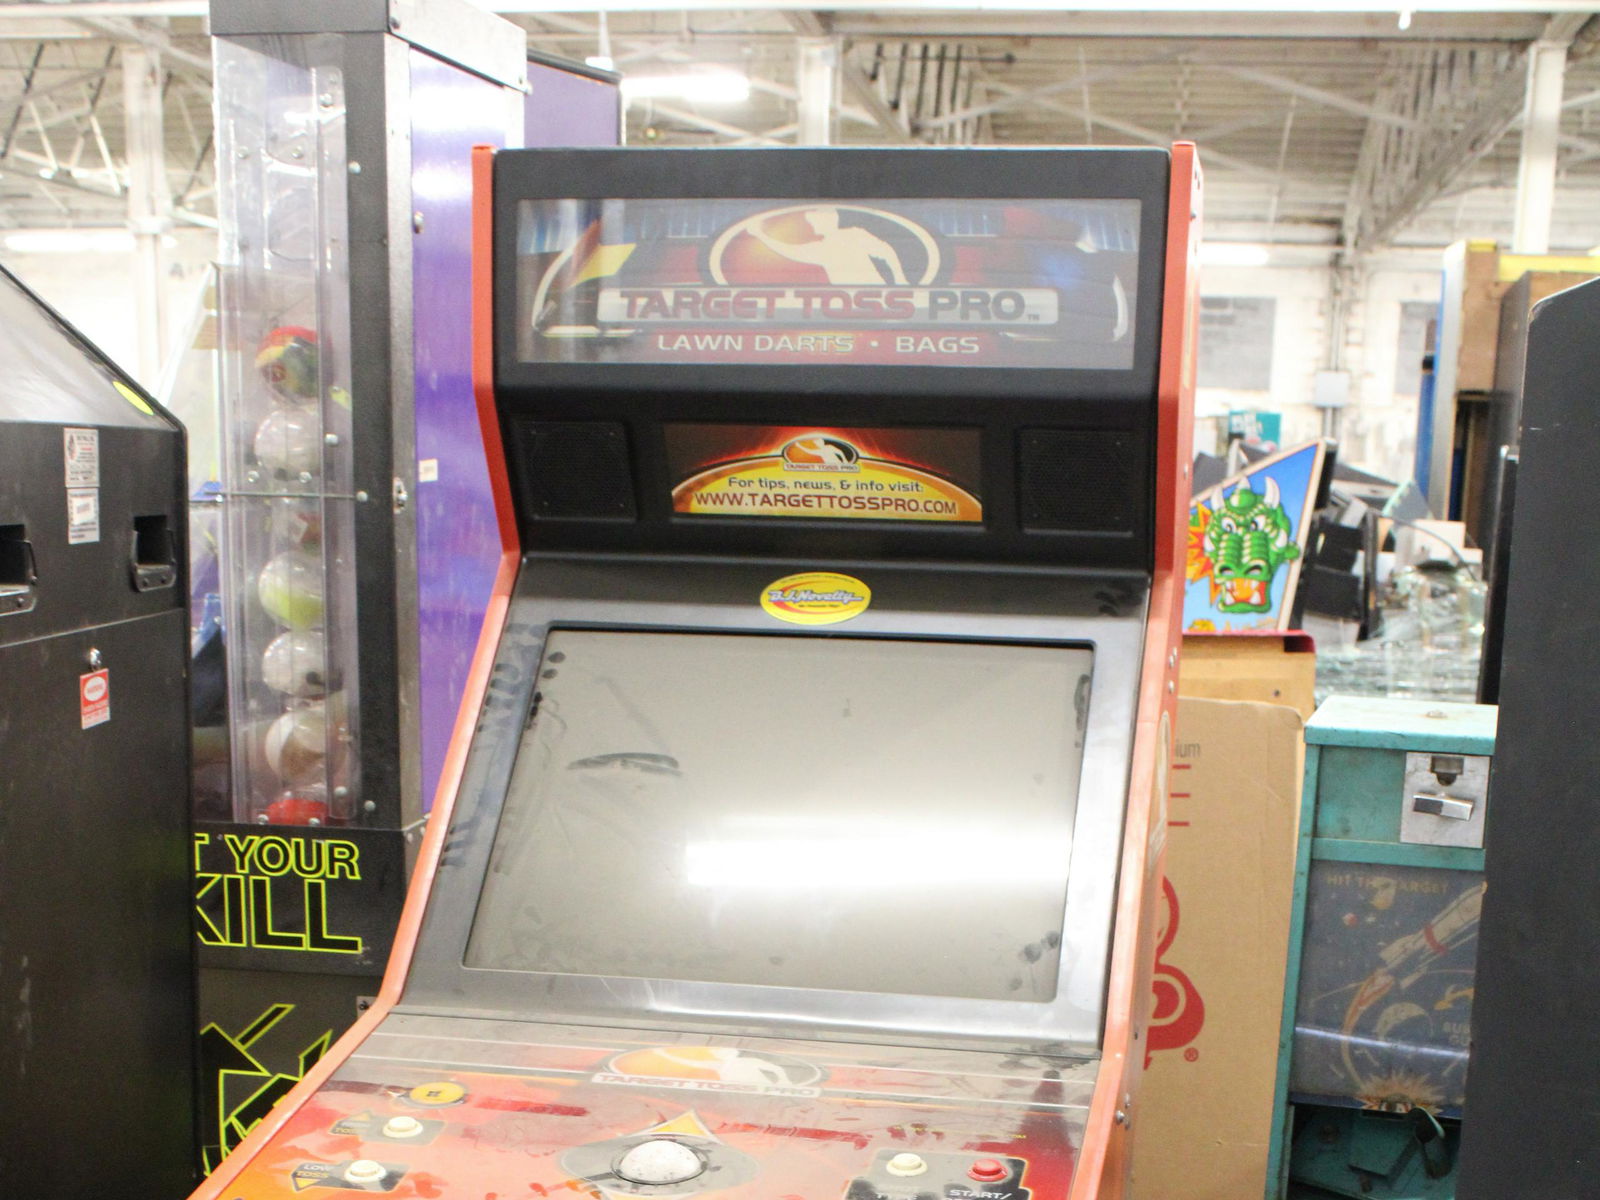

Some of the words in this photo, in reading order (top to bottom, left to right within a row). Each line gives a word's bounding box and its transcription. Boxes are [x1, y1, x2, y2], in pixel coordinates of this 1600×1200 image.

[620, 290, 786, 319] TARGET
[794, 290, 915, 320] TOSS
[928, 290, 1026, 321] PRO
[657, 334, 744, 351] LAWN
[754, 335, 854, 353] DARTS
[896, 336, 980, 353] BAGS
[728, 477, 754, 488] For
[758, 478, 789, 490] tips,
[794, 480, 836, 490] news,
[839, 480, 852, 490] &
[856, 481, 884, 491] info
[694, 493, 957, 515] WWW.TARGETTOSSPRO.COM
[224, 834, 361, 879] YOUR
[600, 1075, 692, 1088] TARGET
[761, 1086, 816, 1096] PRO
[949, 1189, 1012, 1200] START/
